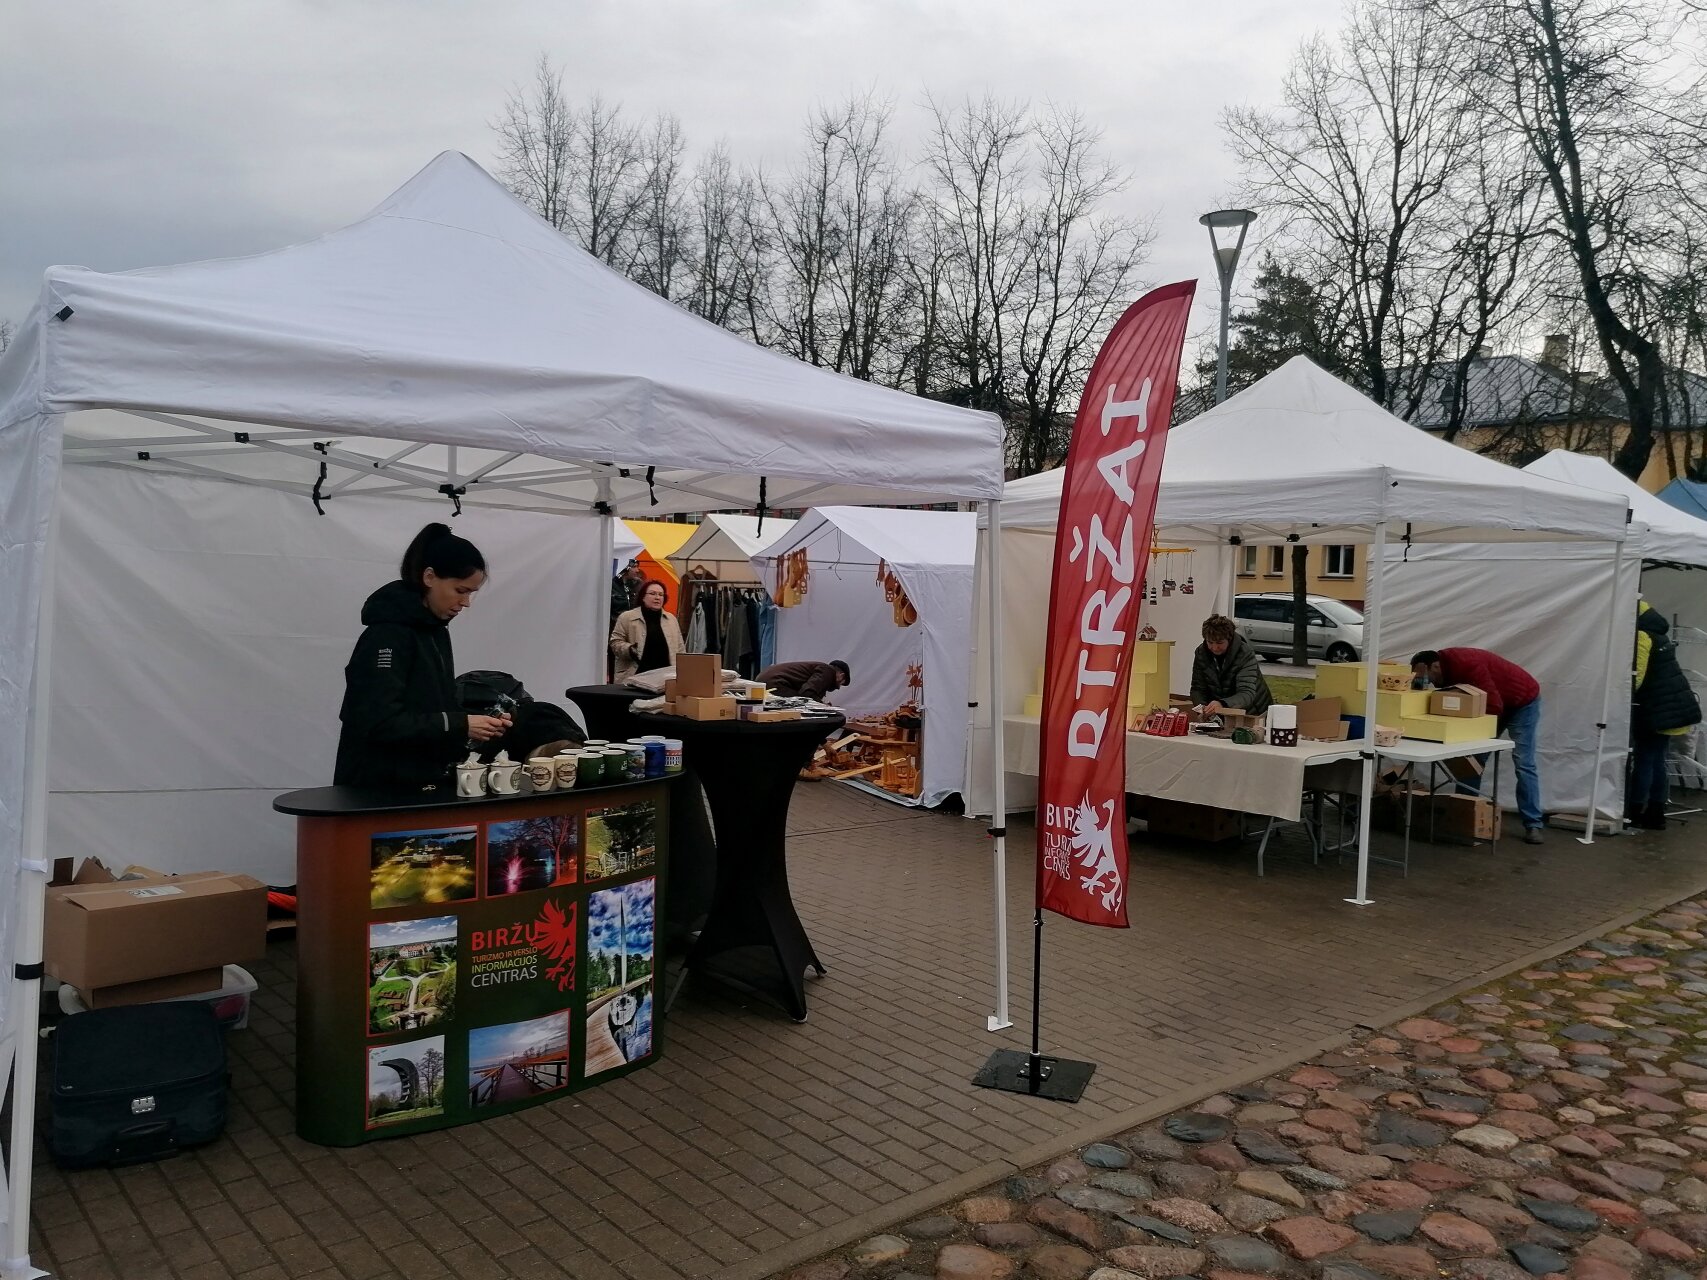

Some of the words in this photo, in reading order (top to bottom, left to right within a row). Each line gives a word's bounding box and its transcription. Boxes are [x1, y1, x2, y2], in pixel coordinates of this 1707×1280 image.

[472, 952, 504, 964] TURIZMO
[505, 950, 513, 959] IR
[513, 946, 538, 957] VERSLO
[472, 955, 538, 974] INFORMACIJOS
[471, 965, 538, 988] CENTRAS
